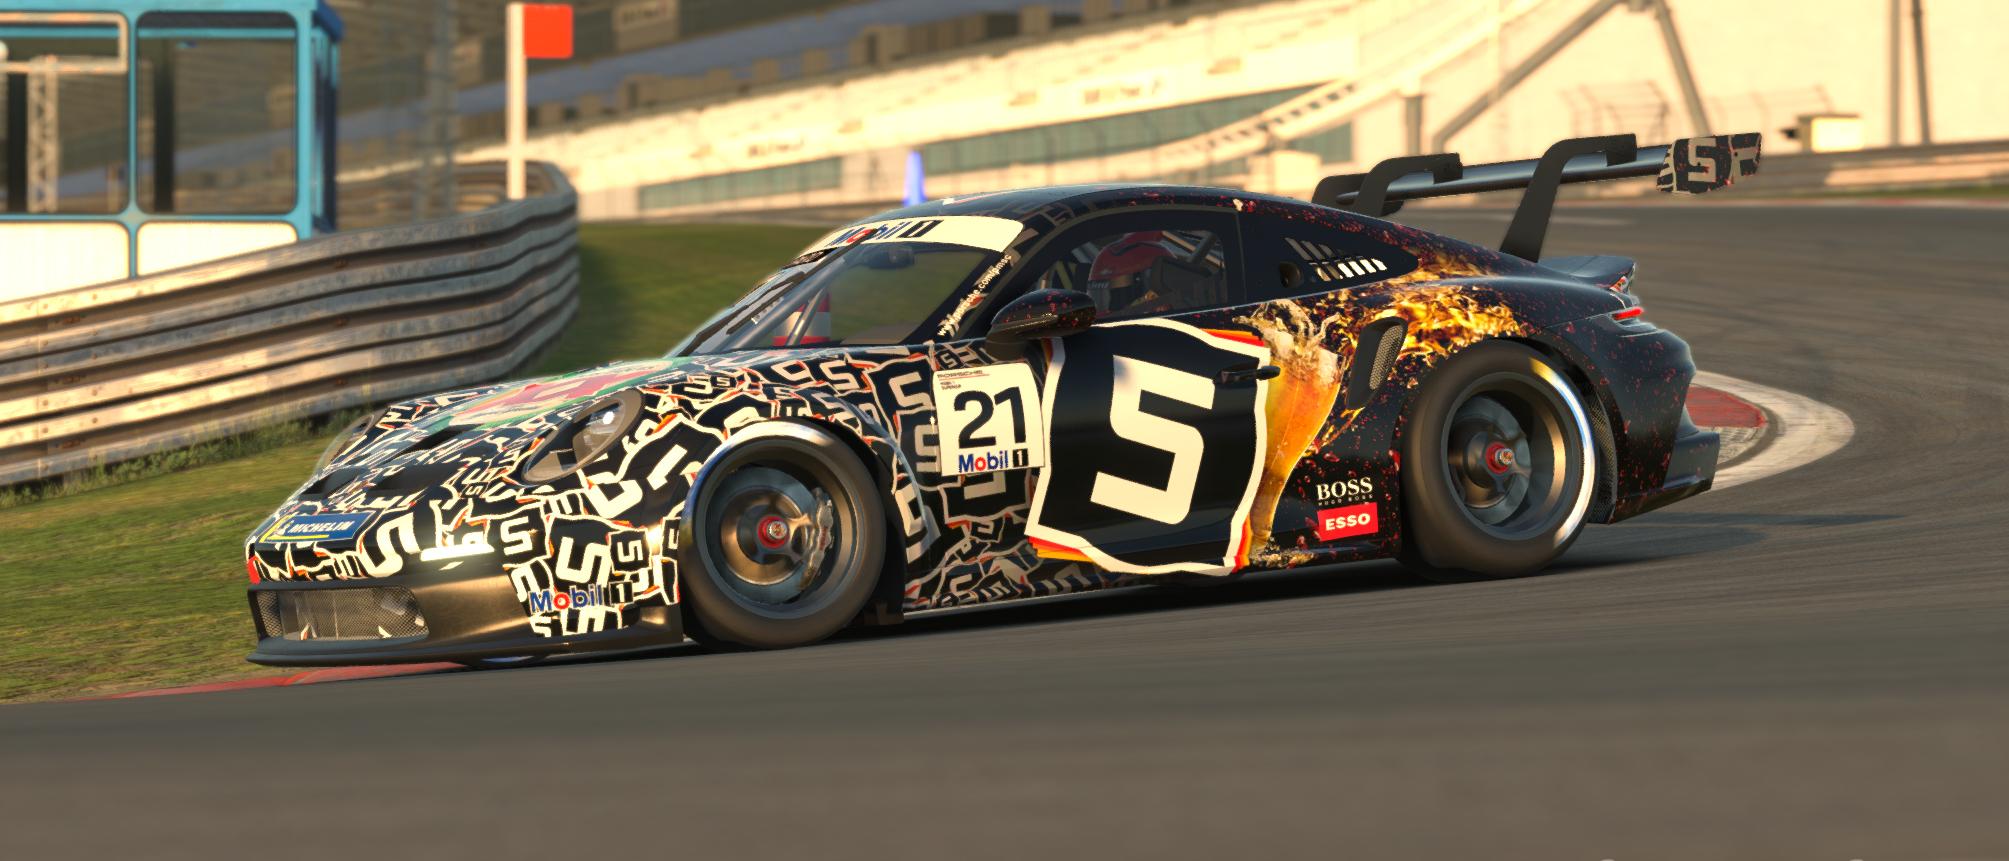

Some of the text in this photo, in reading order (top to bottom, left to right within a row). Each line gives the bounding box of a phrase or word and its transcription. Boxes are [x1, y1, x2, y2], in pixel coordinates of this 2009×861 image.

[953, 386, 1027, 450] 21
[959, 450, 1009, 473] Mobil
[1316, 476, 1373, 501] BOSS
[287, 520, 355, 534] MICHELIN
[1325, 513, 1371, 531] ESSO
[528, 583, 605, 614] Mobil
